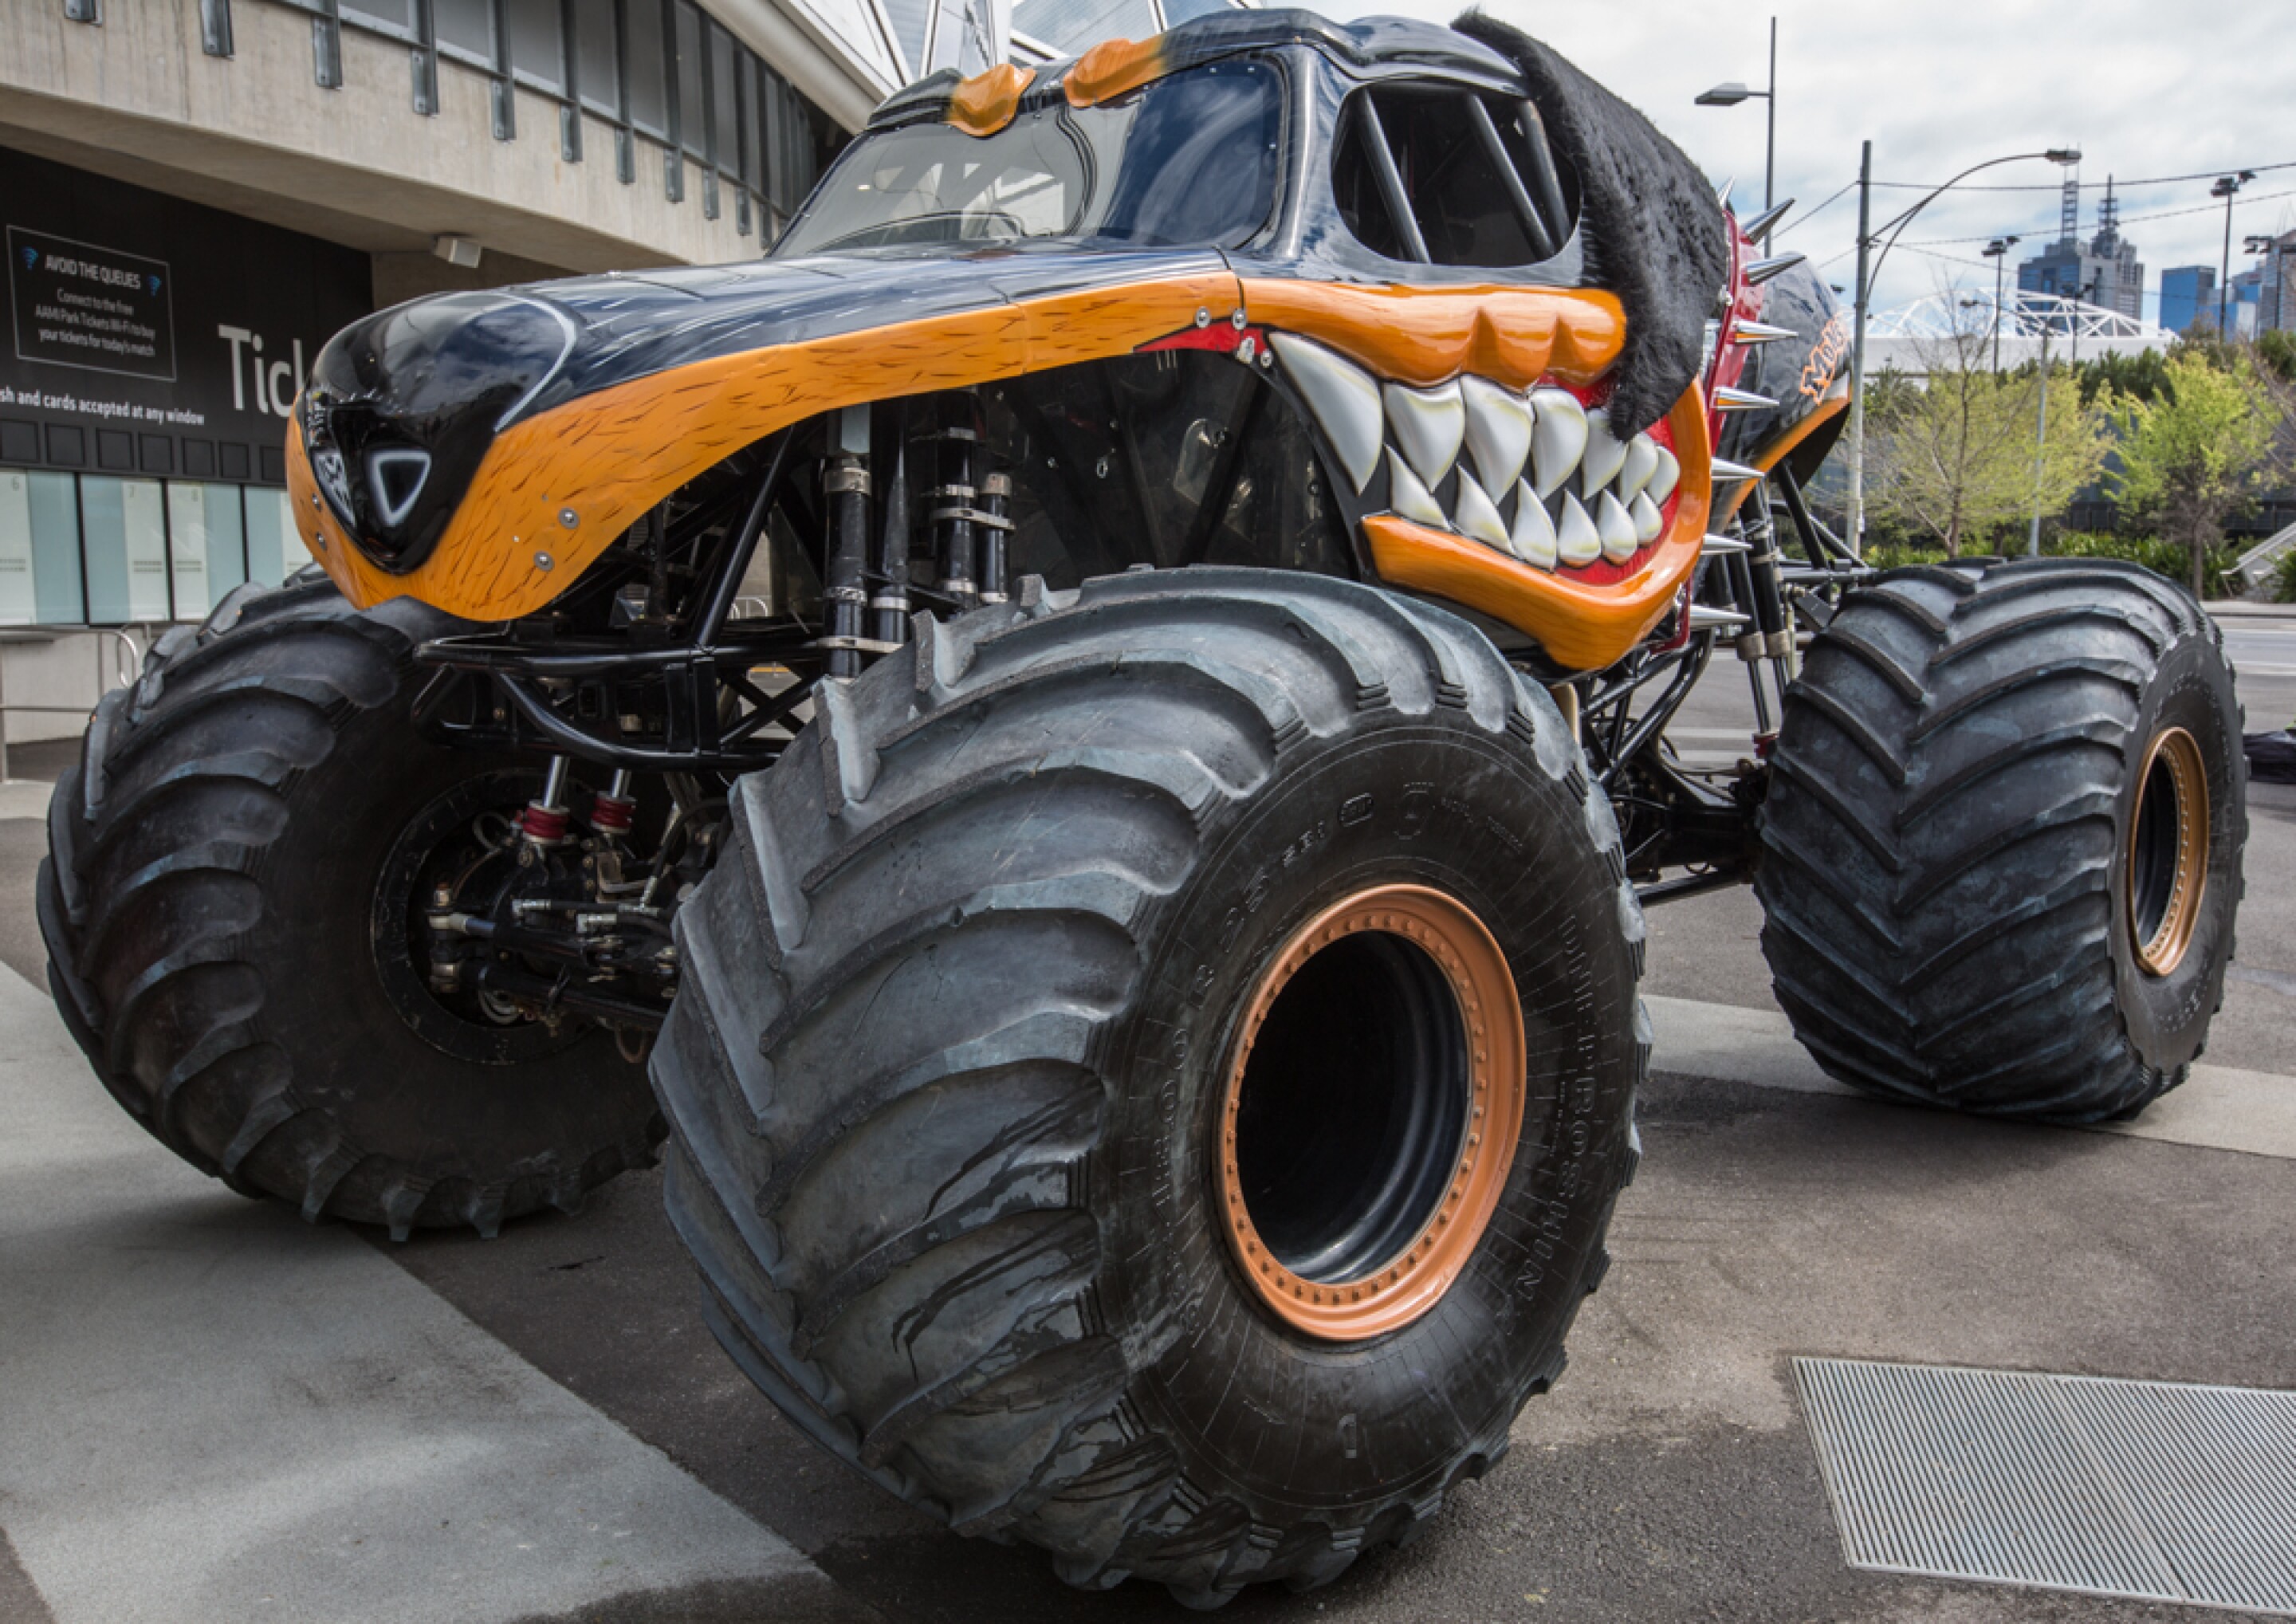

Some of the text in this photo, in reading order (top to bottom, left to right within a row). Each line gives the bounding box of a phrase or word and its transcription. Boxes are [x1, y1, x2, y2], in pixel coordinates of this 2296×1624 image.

[45, 254, 141, 289] AVOID THE QUEUES
[57, 287, 134, 317] Connect to the free
[60, 307, 80, 324] Park
[59, 331, 88, 347] tickets
[88, 333, 101, 348] for
[102, 338, 130, 355] today's
[131, 343, 155, 358] match
[17, 388, 41, 407] and
[42, 392, 77, 411] cards
[78, 399, 130, 419] accepted
[132, 405, 143, 419] at
[145, 407, 164, 426] any
[166, 407, 205, 426] window
